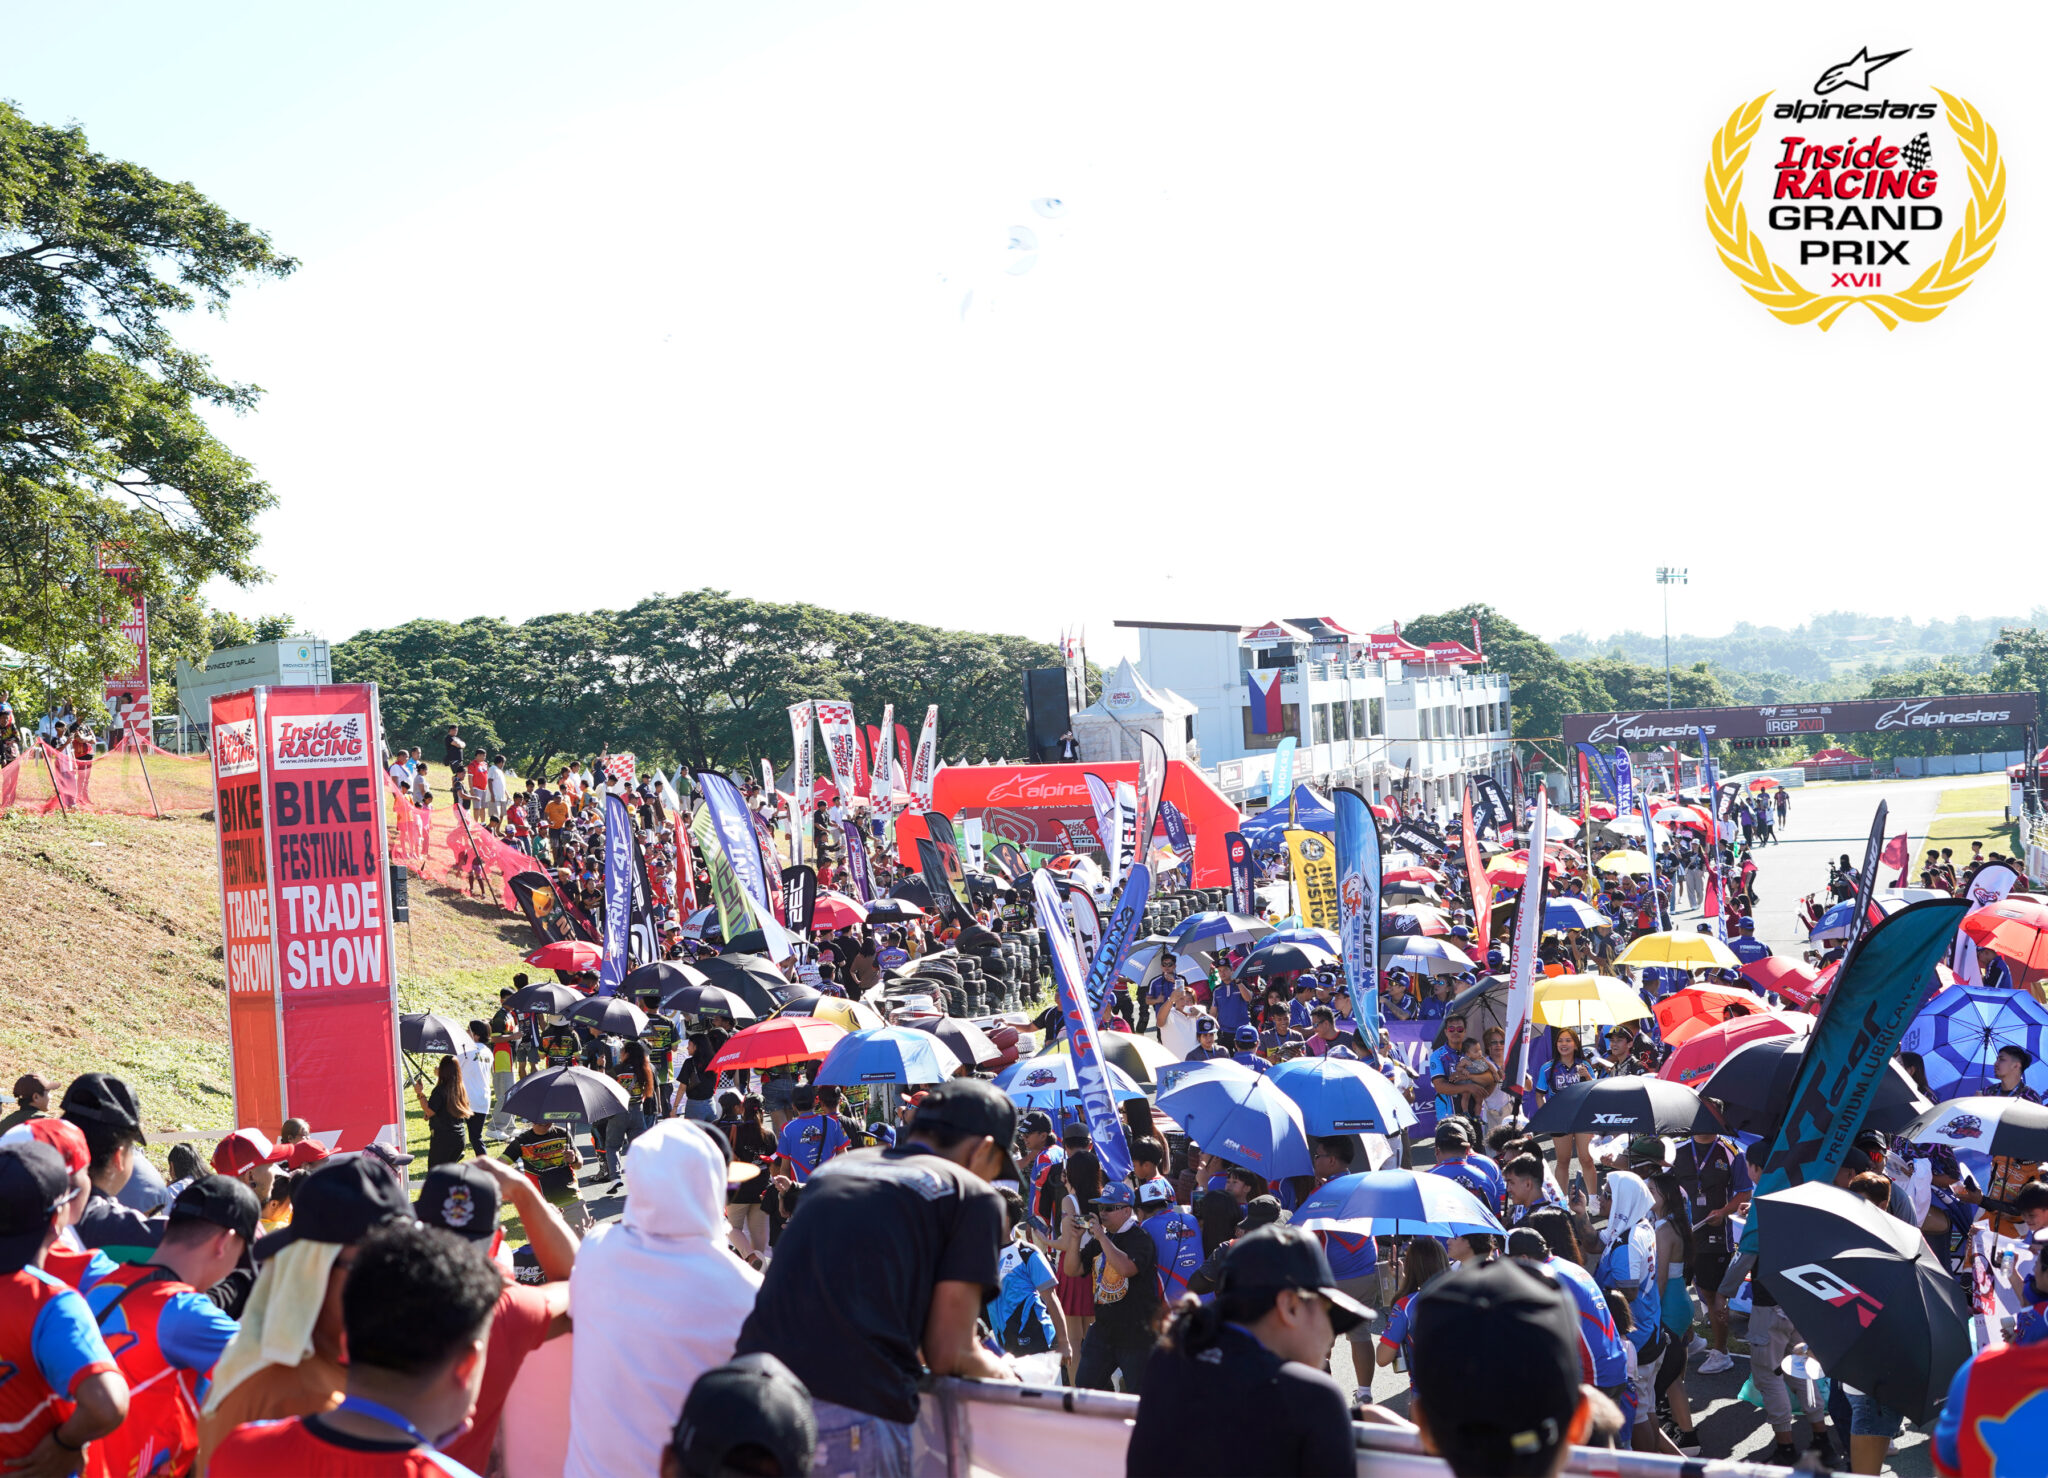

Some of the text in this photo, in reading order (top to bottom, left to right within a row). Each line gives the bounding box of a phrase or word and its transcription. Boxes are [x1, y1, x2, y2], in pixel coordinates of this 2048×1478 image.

[219, 729, 246, 751] Inside
[278, 720, 342, 742] Inside
[1910, 709, 2011, 727] alpinestars
[219, 743, 256, 766] RACING
[278, 738, 363, 758] RACING
[280, 756, 363, 765] www.insideracing.com.ph
[220, 783, 261, 834] BIKE
[276, 778, 372, 828] BIKE
[719, 810, 742, 841] 4T
[225, 837, 257, 888] FESTIVAL
[280, 829, 376, 881] FESTIVAL &
[613, 837, 626, 871] 4T
[227, 887, 269, 940] TRADE
[282, 880, 380, 935] TRADE
[1318, 859, 1339, 932] IMPRIN
[230, 942, 272, 994] SHOW
[287, 934, 382, 990] SHOW
[1509, 945, 1520, 990] MOTOR
[716, 1051, 741, 1065] MOTUL
[1591, 1113, 1638, 1124] XTeer
[1824, 1079, 1870, 1165] PREMIUM
